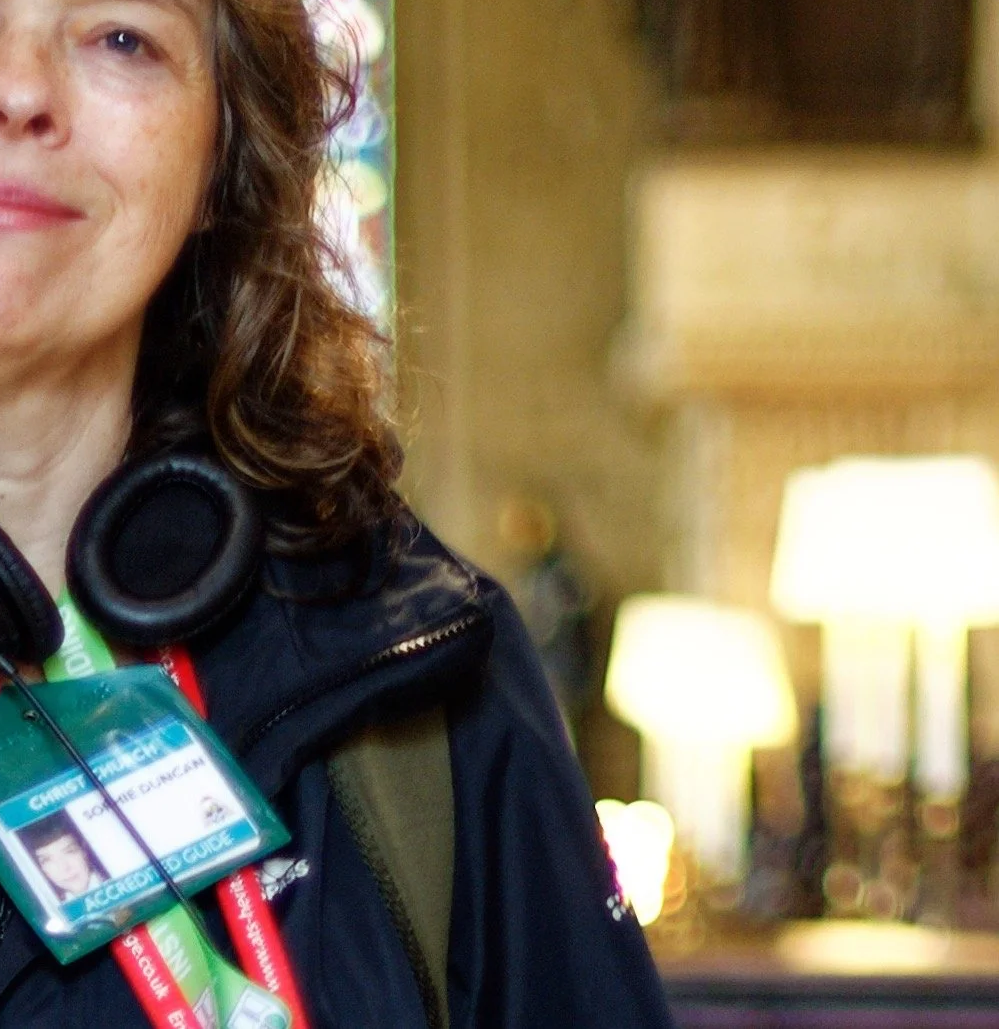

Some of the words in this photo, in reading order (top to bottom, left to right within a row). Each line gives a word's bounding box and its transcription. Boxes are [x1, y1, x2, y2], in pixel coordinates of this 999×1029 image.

[28, 774, 87, 812] CHRIST
[139, 756, 206, 794] DUNCAN
[182, 828, 235, 864] GUIDE
